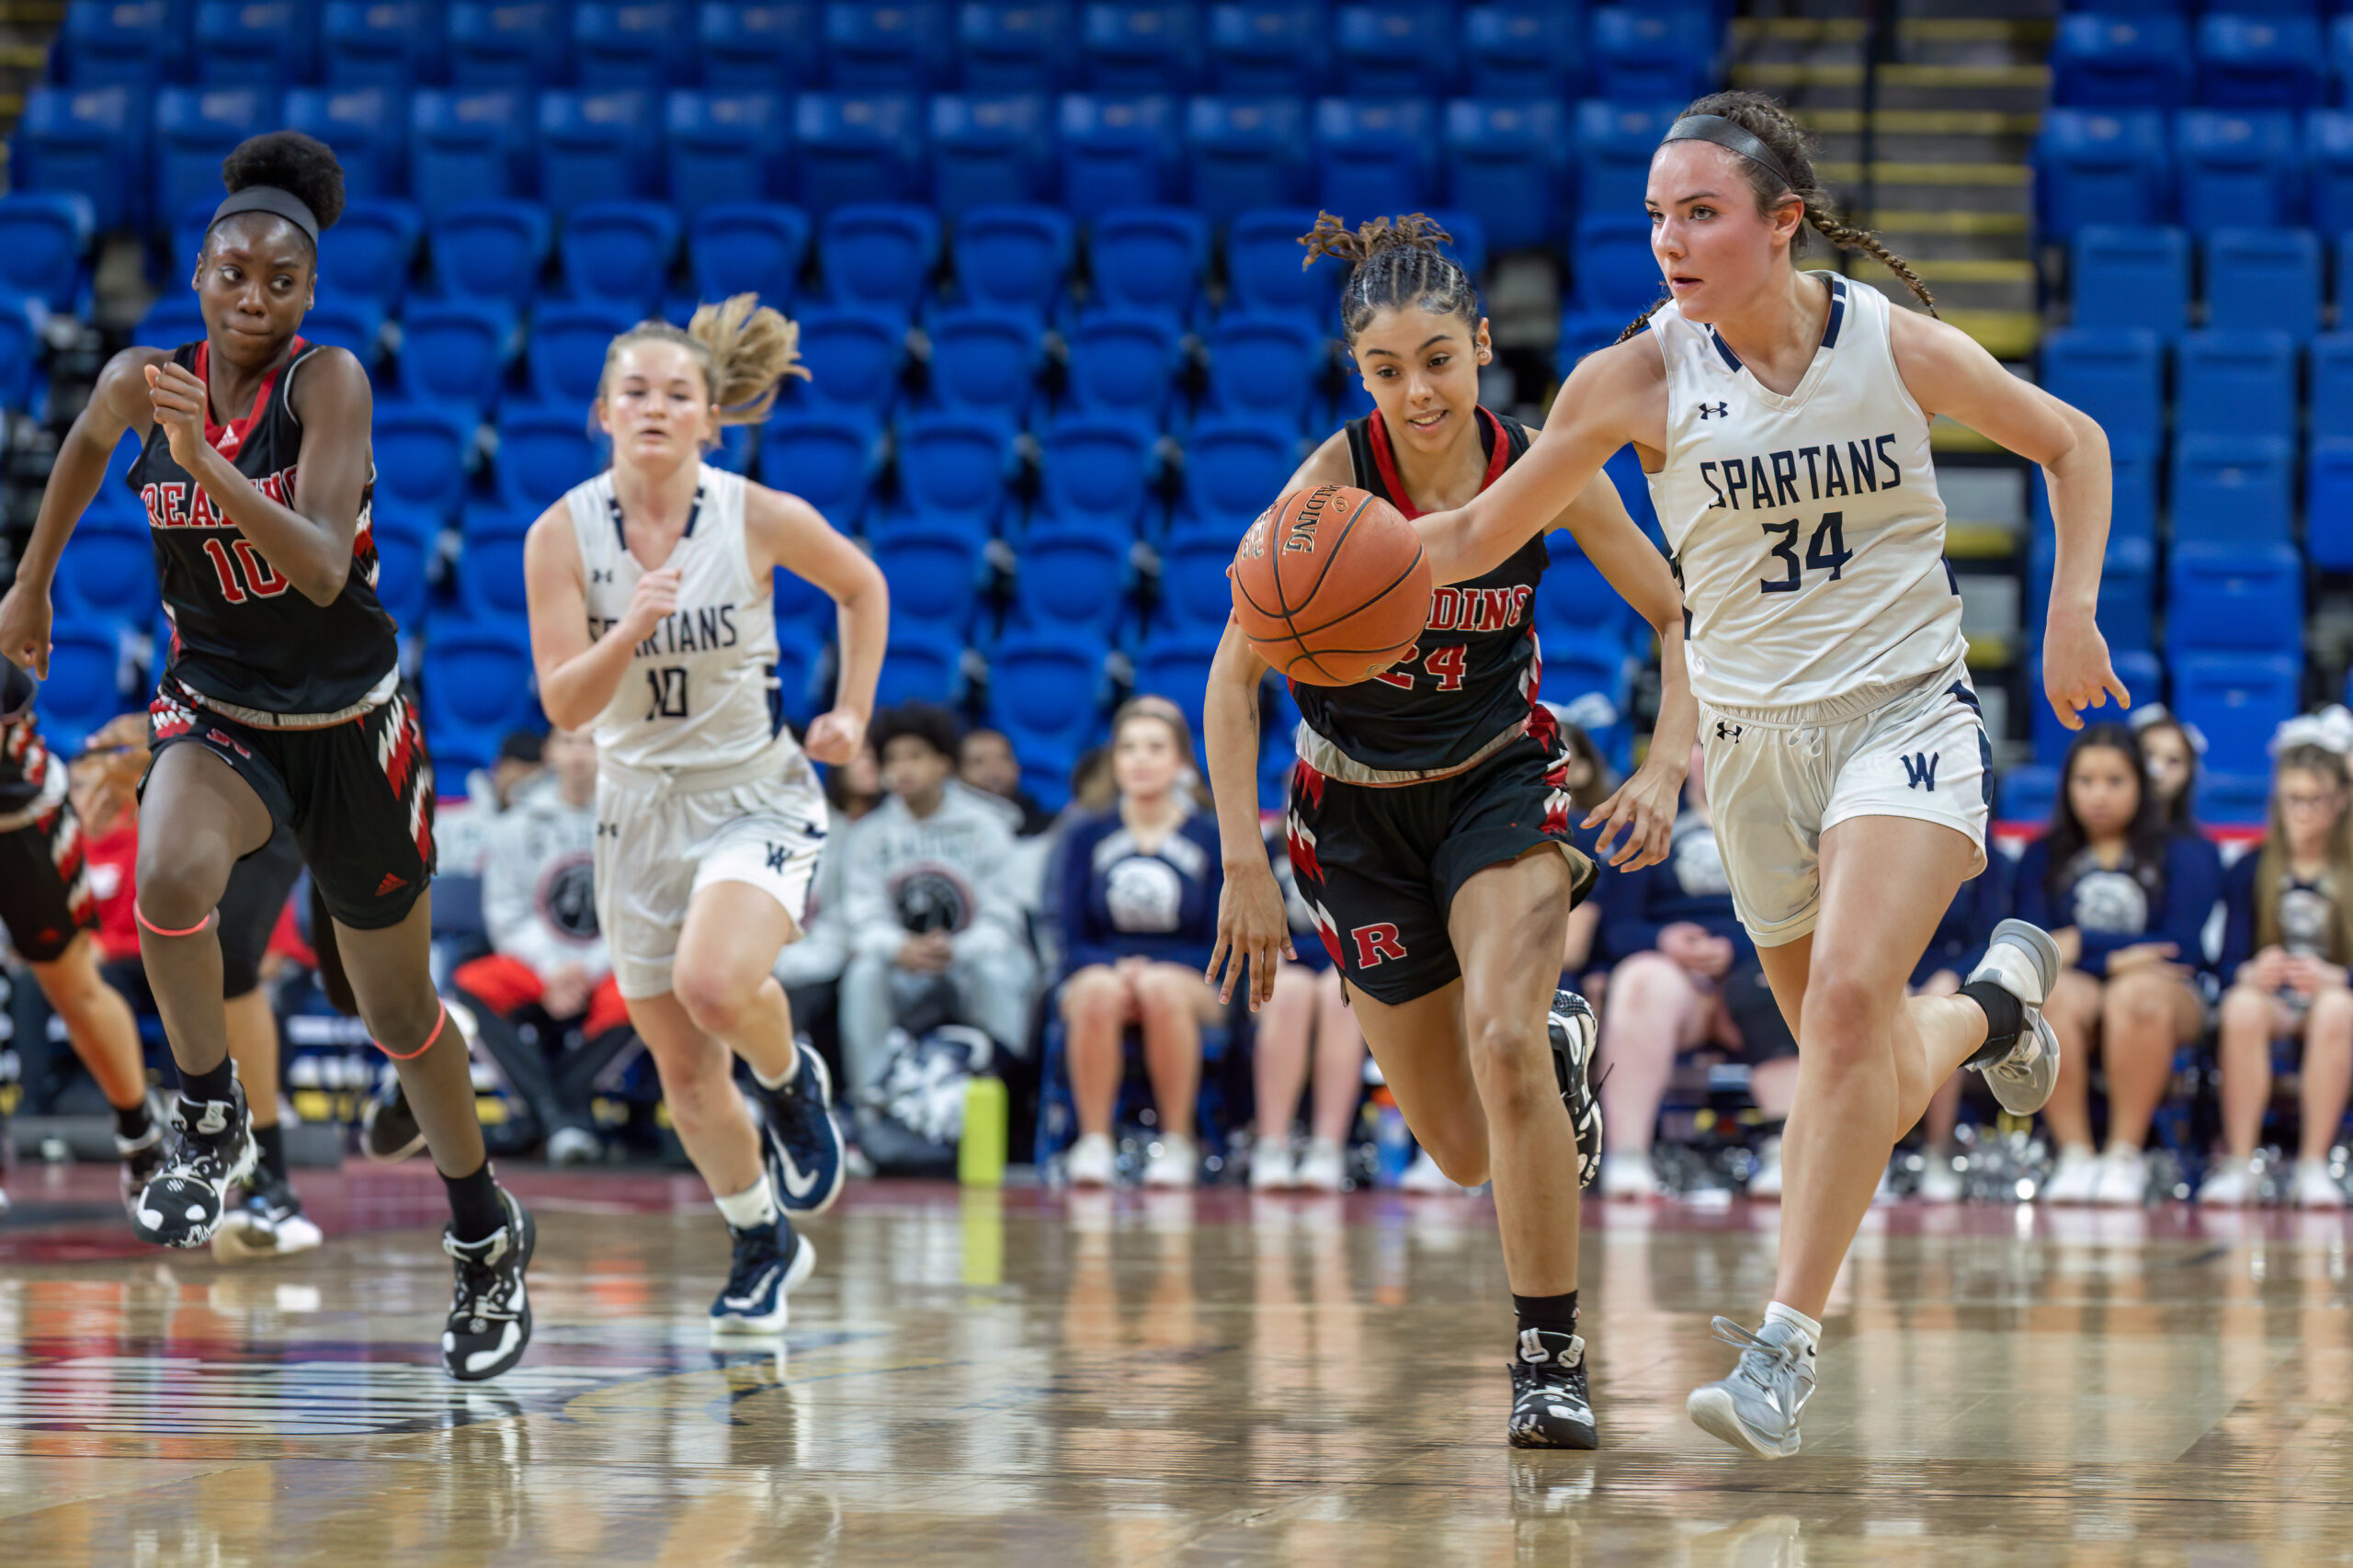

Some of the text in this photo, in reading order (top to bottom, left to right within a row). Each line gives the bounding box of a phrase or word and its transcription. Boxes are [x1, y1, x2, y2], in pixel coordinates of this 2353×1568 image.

[1699, 433, 1901, 510] SPARTANS
[202, 538, 290, 605] 10
[1759, 511, 1853, 594] 34
[645, 666, 688, 722] 10
[1899, 751, 1940, 792] W
[1350, 922, 1408, 970] R
